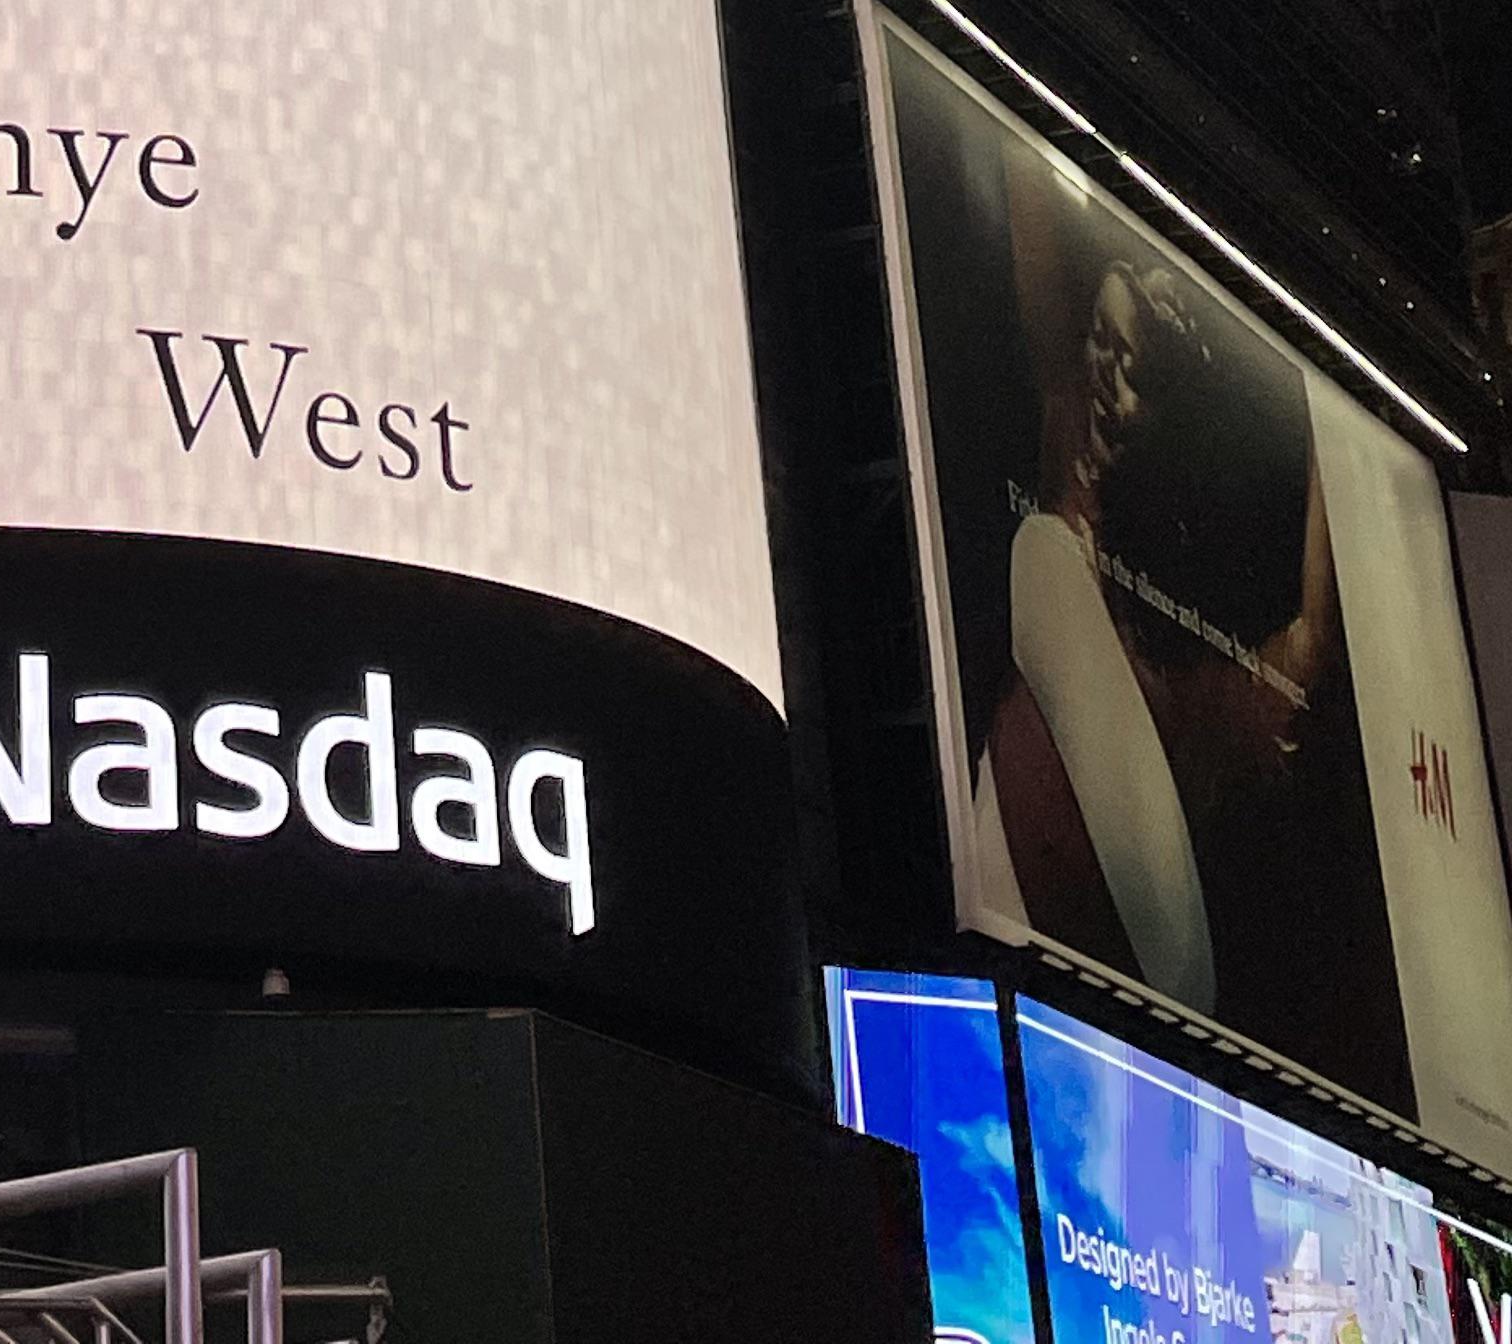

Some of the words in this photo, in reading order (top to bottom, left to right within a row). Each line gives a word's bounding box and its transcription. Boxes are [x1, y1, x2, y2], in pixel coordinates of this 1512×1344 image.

[136, 328, 474, 492] West
[1057, 1213, 1161, 1296] Designed
[1162, 1251, 1189, 1316] by
[1192, 1265, 1256, 1334] Bjarke
